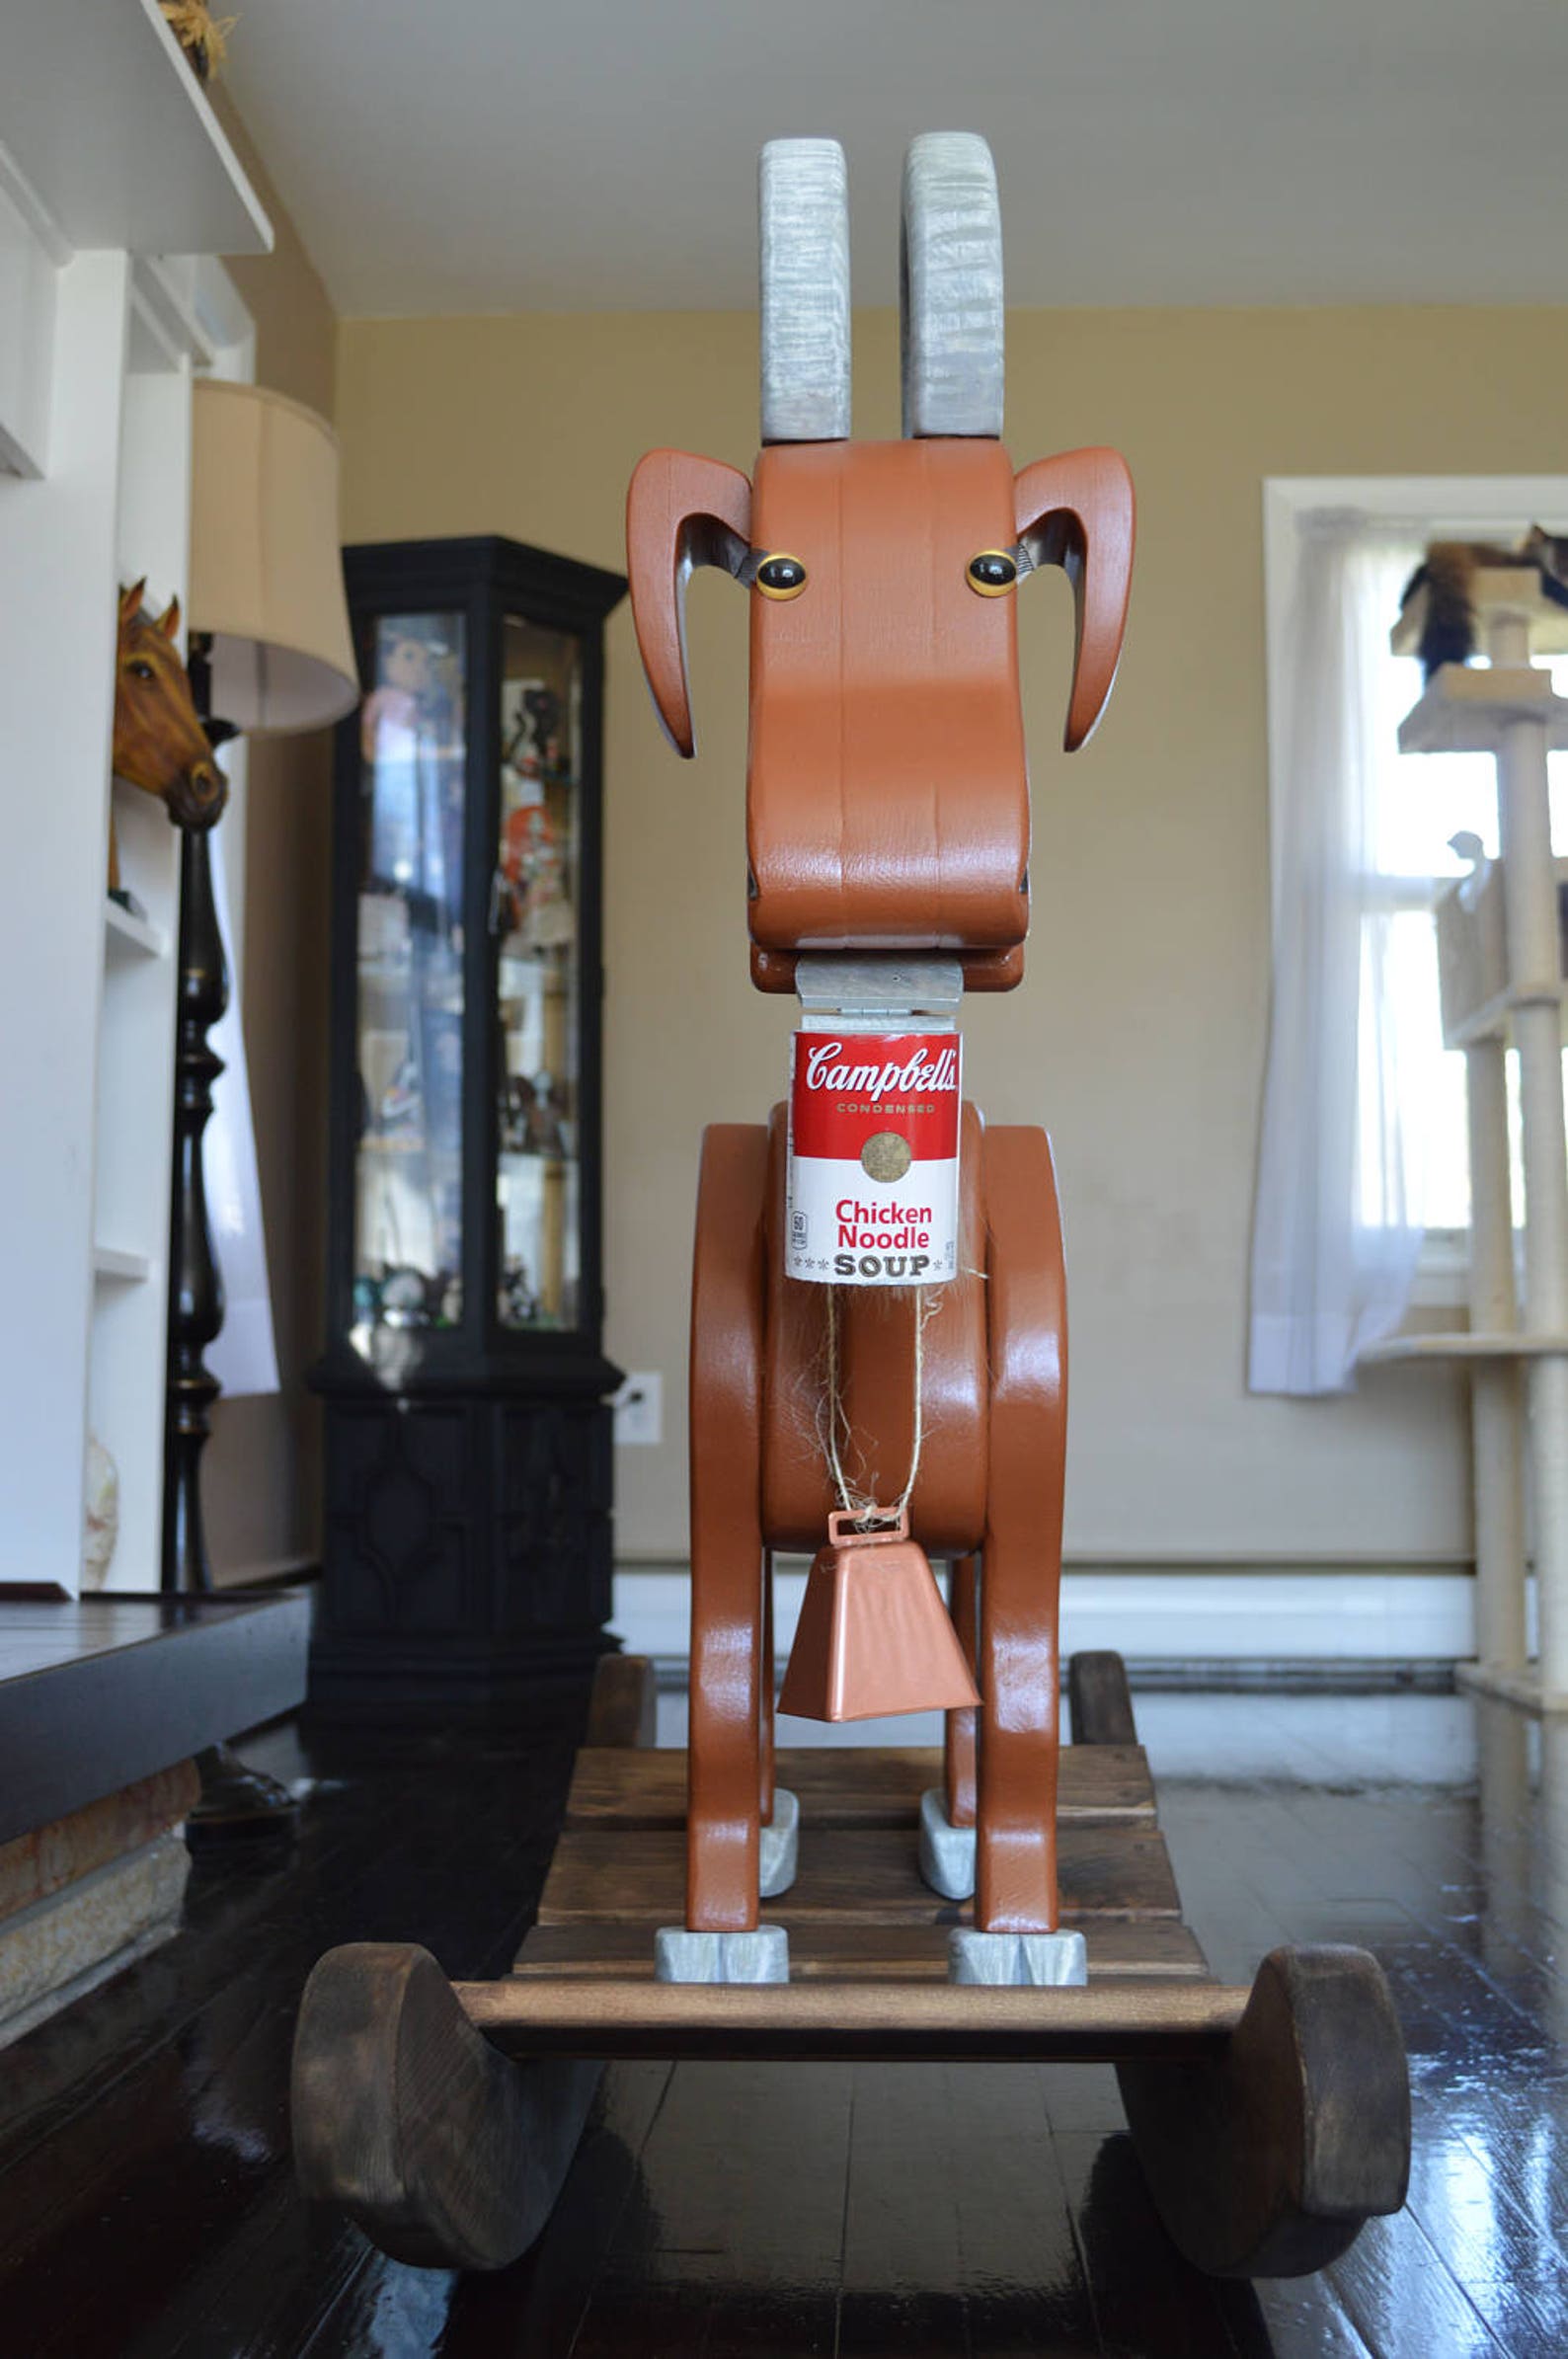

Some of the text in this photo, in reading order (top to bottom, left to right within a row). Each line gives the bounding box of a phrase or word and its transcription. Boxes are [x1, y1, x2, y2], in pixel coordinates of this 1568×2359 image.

[836, 1103, 935, 1114] CONDENSED
[835, 1199, 932, 1224] Chicken
[838, 1225, 930, 1249] Noodle
[834, 1254, 930, 1278] SOUP
